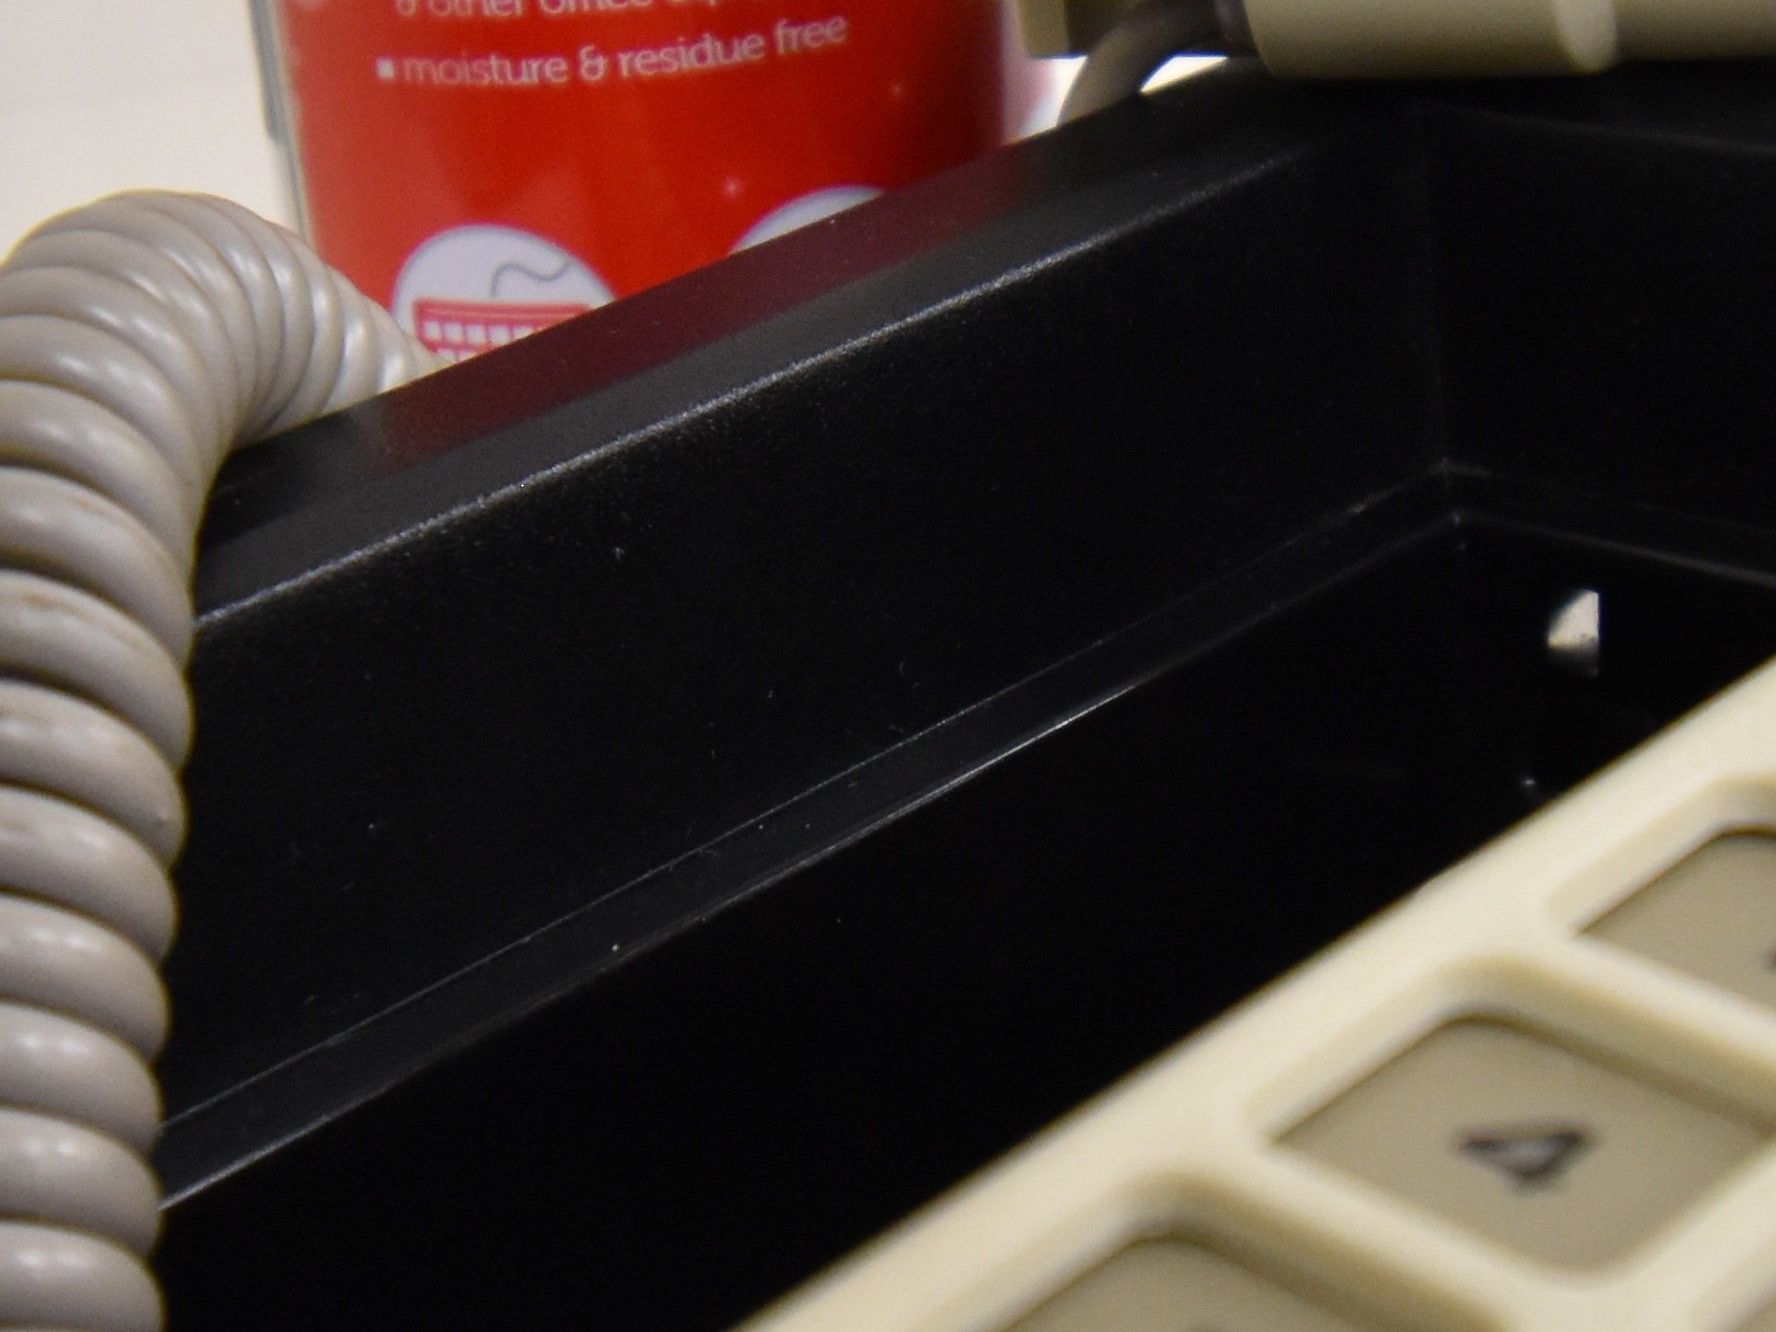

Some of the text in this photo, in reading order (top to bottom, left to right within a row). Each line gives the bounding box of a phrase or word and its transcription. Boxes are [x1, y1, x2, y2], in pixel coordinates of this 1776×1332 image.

[403, 15, 848, 85] moisture & residue free
[1450, 1118, 1600, 1192] 4
